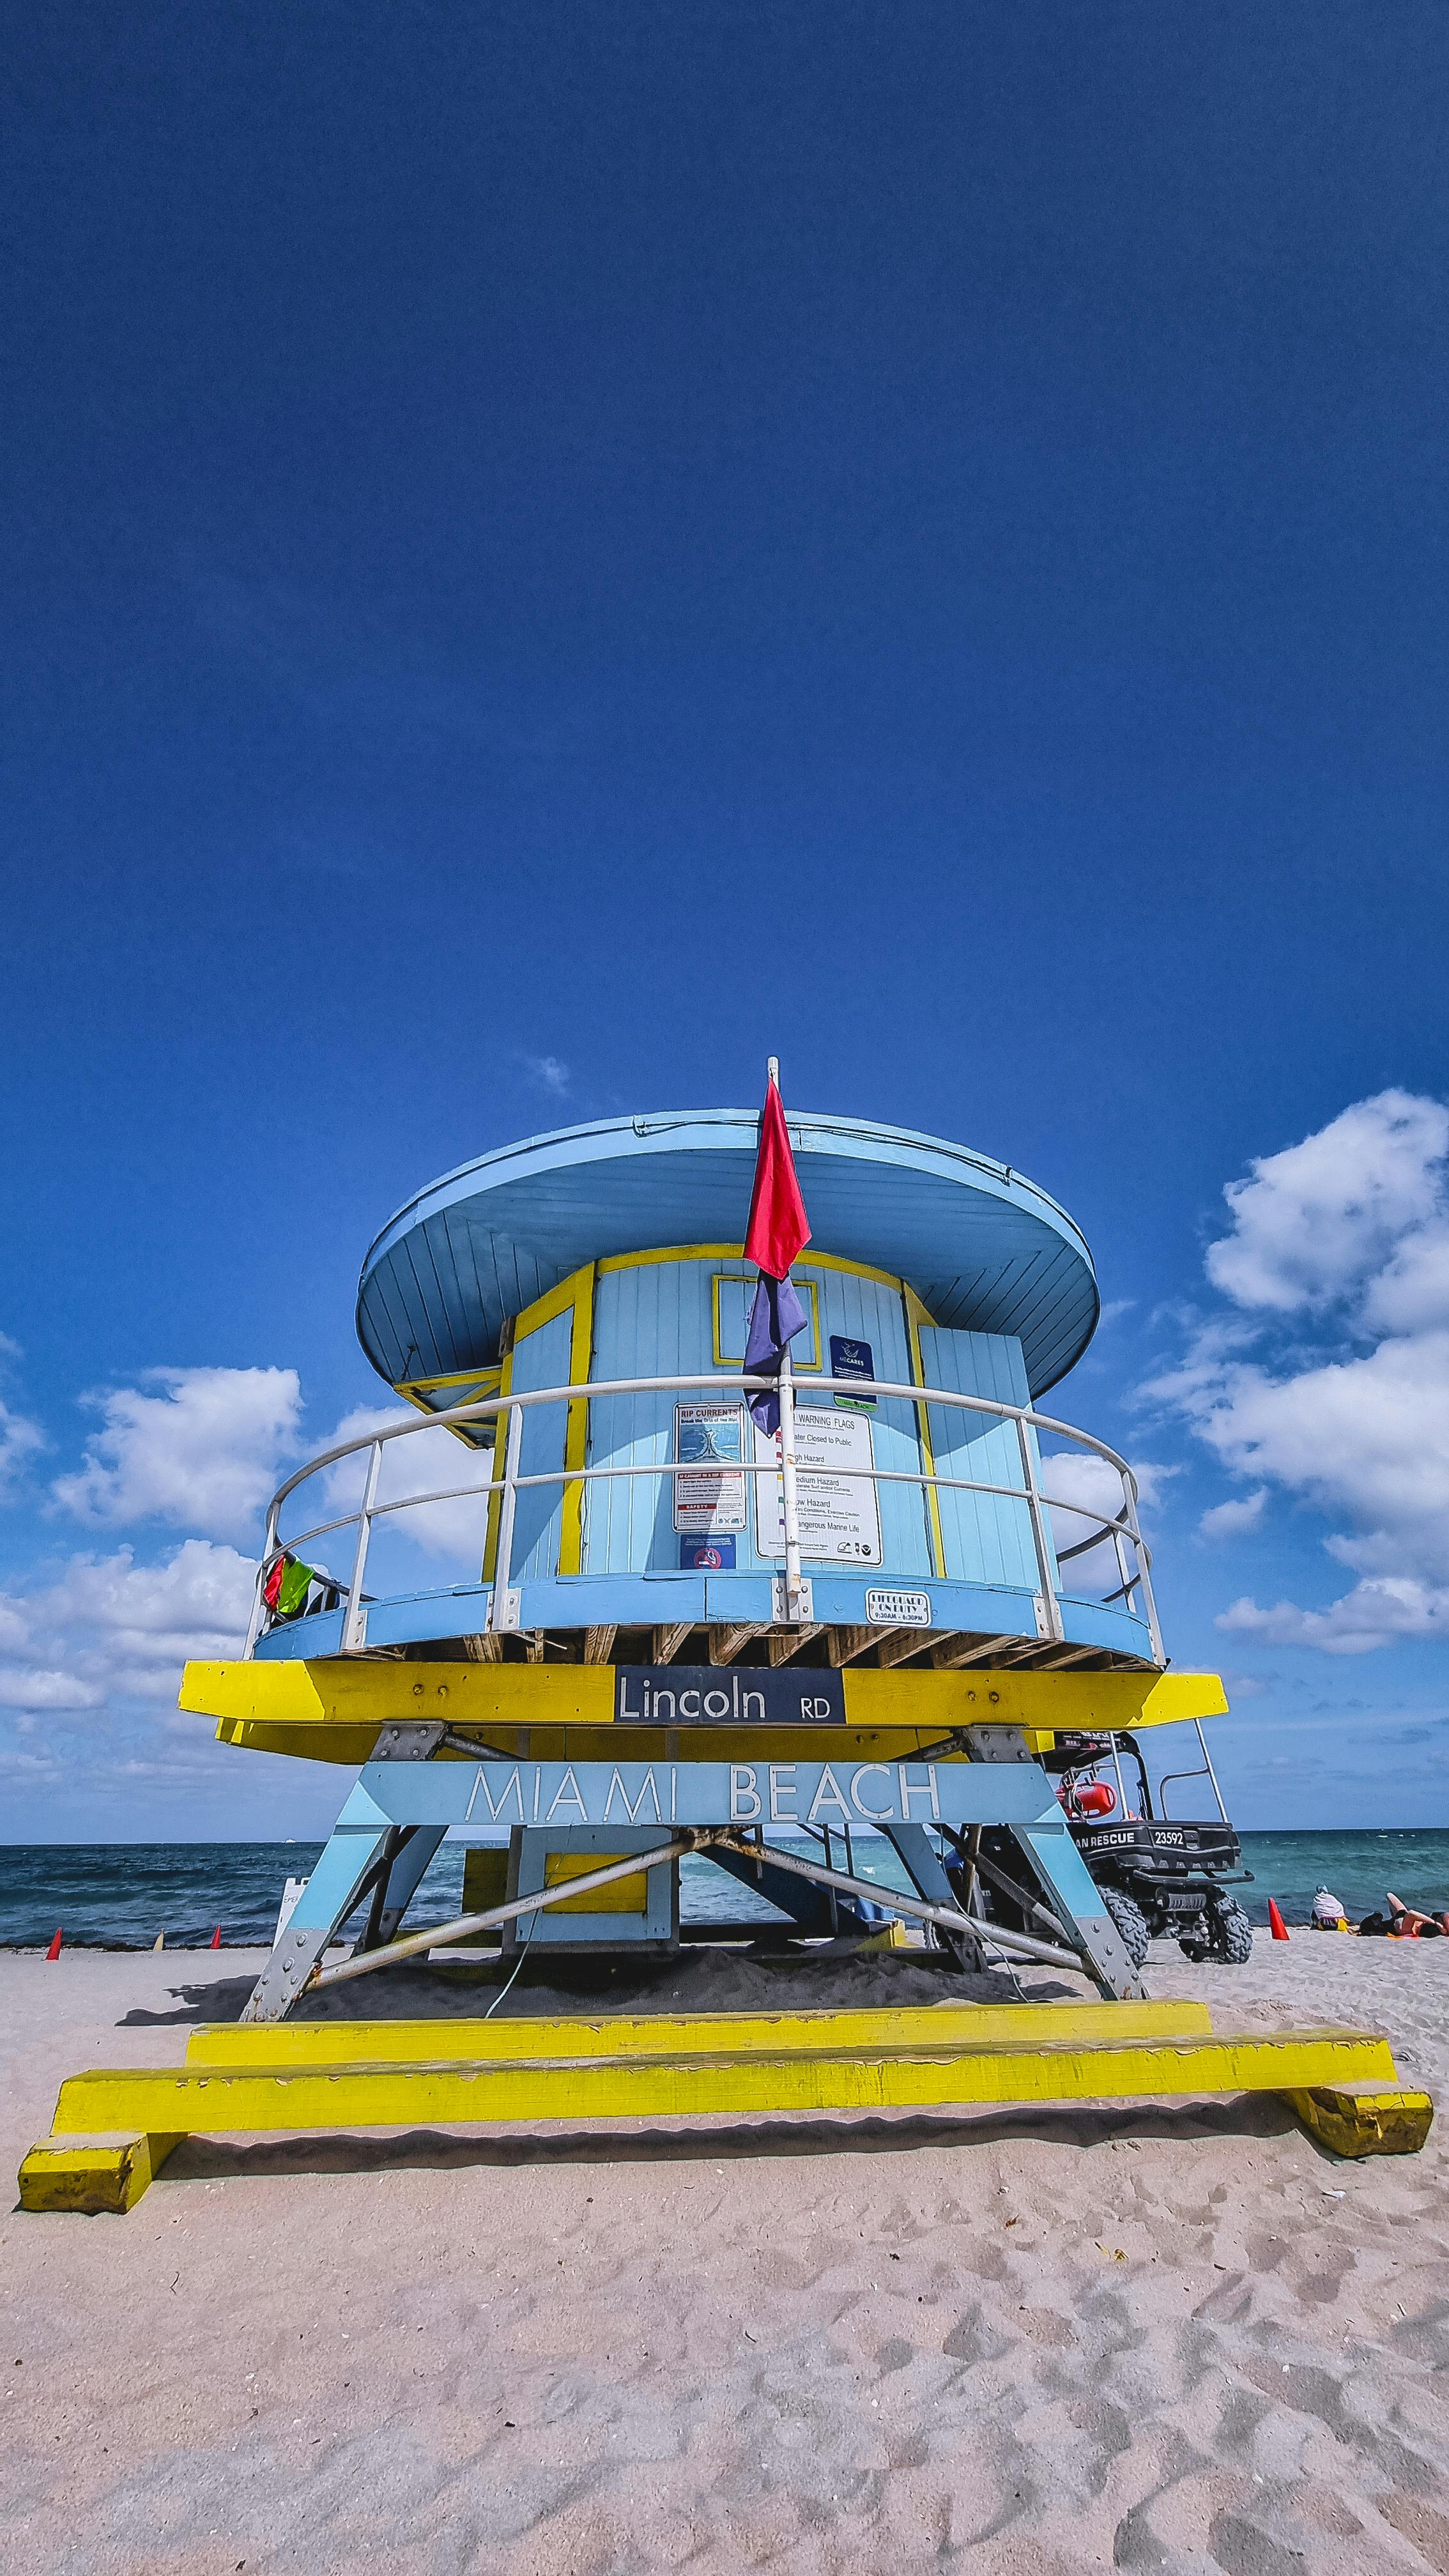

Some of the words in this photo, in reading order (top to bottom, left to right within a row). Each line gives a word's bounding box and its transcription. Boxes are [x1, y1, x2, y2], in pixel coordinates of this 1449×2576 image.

[696, 1409, 738, 1417] CURRENTS
[798, 1413, 831, 1426] WARNING
[834, 1418, 855, 1430] FLAGS
[807, 1434, 827, 1443] Closed
[794, 1453, 802, 1462] gh
[804, 1453, 825, 1462] Hazard
[795, 1476, 816, 1484] edium
[816, 1476, 839, 1487] Hazard
[806, 1498, 831, 1508] Hazard
[797, 1521, 826, 1529] angerous
[827, 1521, 848, 1531] Marine
[848, 1524, 860, 1533] Life
[871, 1594, 923, 1606] LIFEGUARD
[878, 1604, 891, 1612] ON
[893, 1604, 917, 1613] DUTY
[619, 1675, 766, 1719] Lincoln
[800, 1697, 831, 1719] RD
[464, 1765, 677, 1823] MIAMI
[729, 1762, 940, 1821] BEACH
[1090, 1832, 1135, 1847] RESCUE
[1155, 1832, 1184, 1844] 23592
